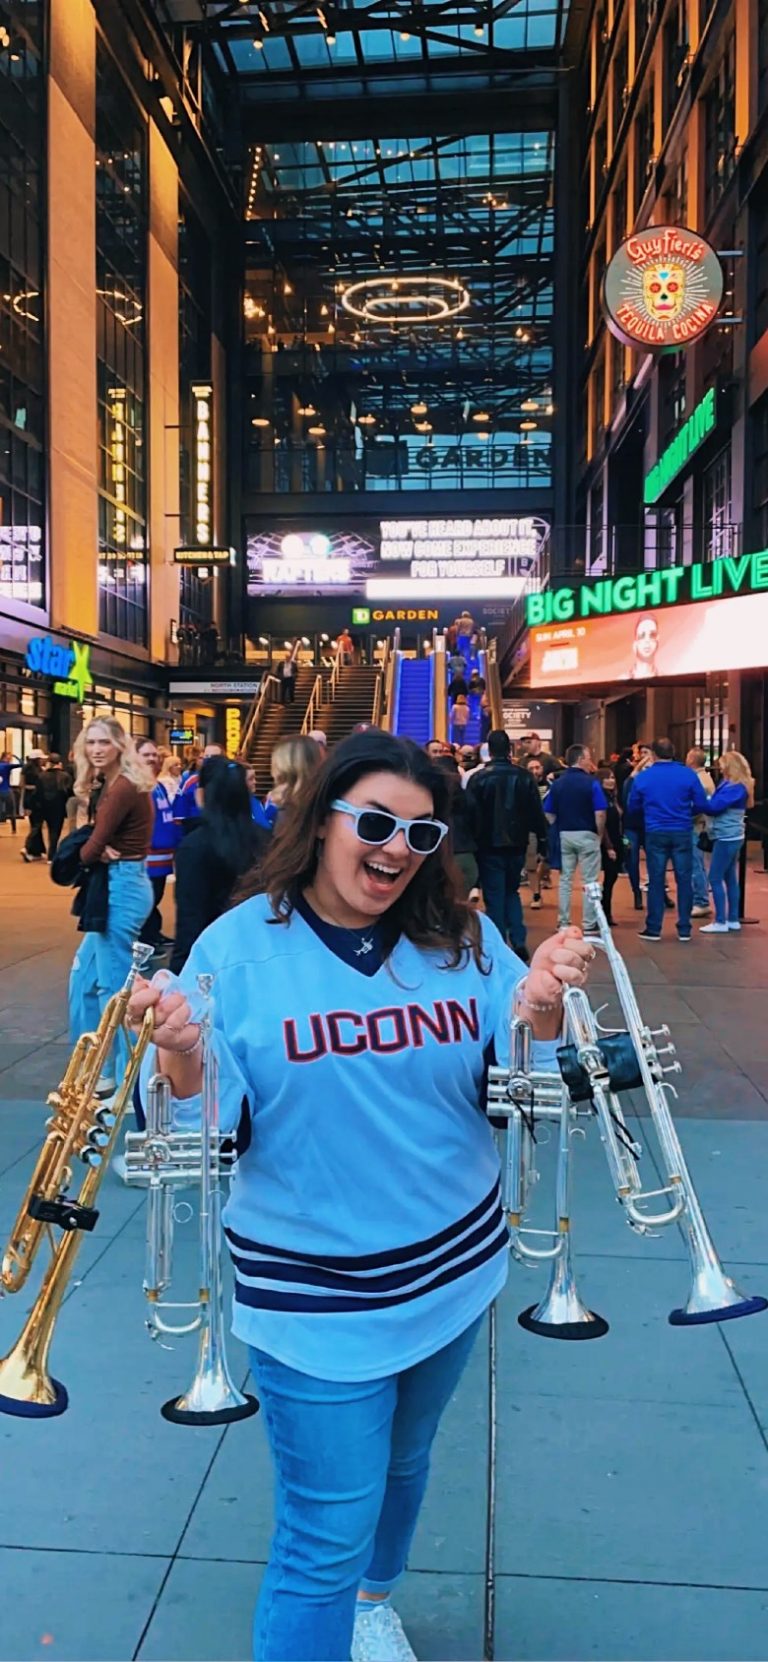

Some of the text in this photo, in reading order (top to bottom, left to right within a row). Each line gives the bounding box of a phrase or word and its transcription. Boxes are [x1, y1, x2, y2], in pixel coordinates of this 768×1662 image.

[626, 238, 661, 265] Guy
[616, 303, 714, 340] TEQUILA COCINA
[688, 387, 715, 453] LIVE
[416, 443, 551, 469] GARDEN
[197, 400, 210, 543] BANNERS
[428, 520, 472, 539] HEARD
[473, 519, 517, 538] ABOUT
[214, 551, 229, 559] TAP
[381, 539, 536, 559] NOW COME EXPERIENCE
[411, 559, 505, 577] FOR YOURSELF
[526, 551, 768, 626] BIG NIGHT LIVE
[372, 610, 438, 620] GARDEN
[553, 629, 575, 640] APRIL
[283, 998, 480, 1064] UCONN
